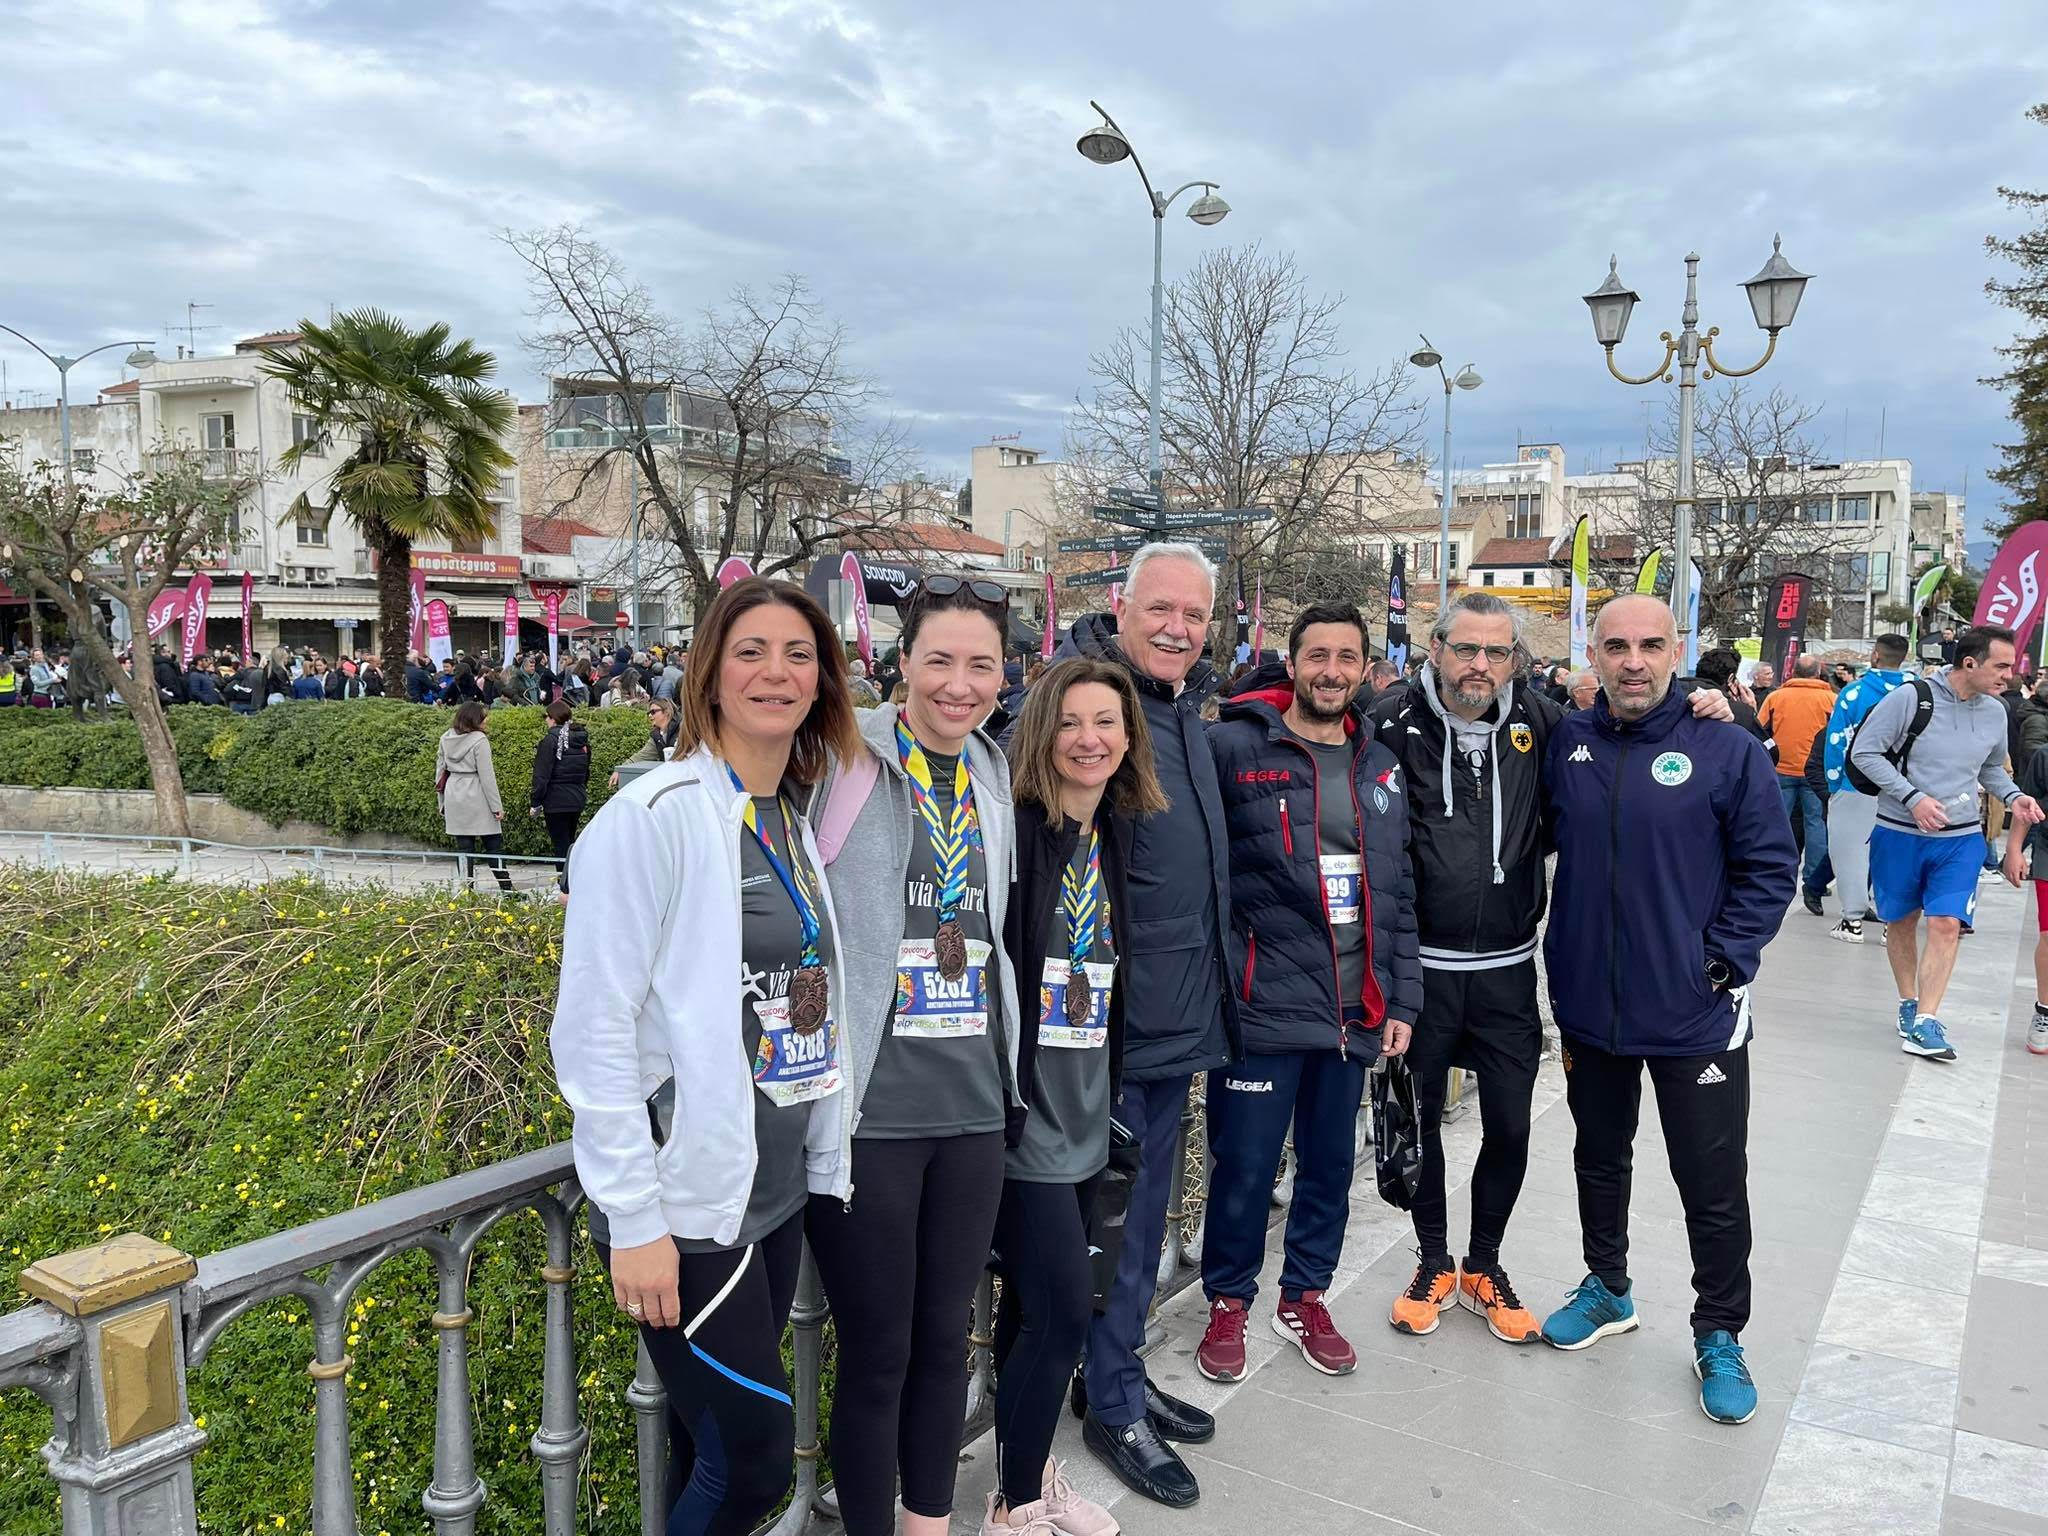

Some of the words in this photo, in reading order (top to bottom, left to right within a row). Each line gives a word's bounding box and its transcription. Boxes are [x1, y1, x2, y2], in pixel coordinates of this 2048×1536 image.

[863, 564, 906, 587] saucony
[1237, 769, 1291, 784] LEGEA
[781, 1028, 826, 1065] 5288
[1225, 1077, 1273, 1092] LEGEA
[1696, 1074, 1727, 1085] adidas
